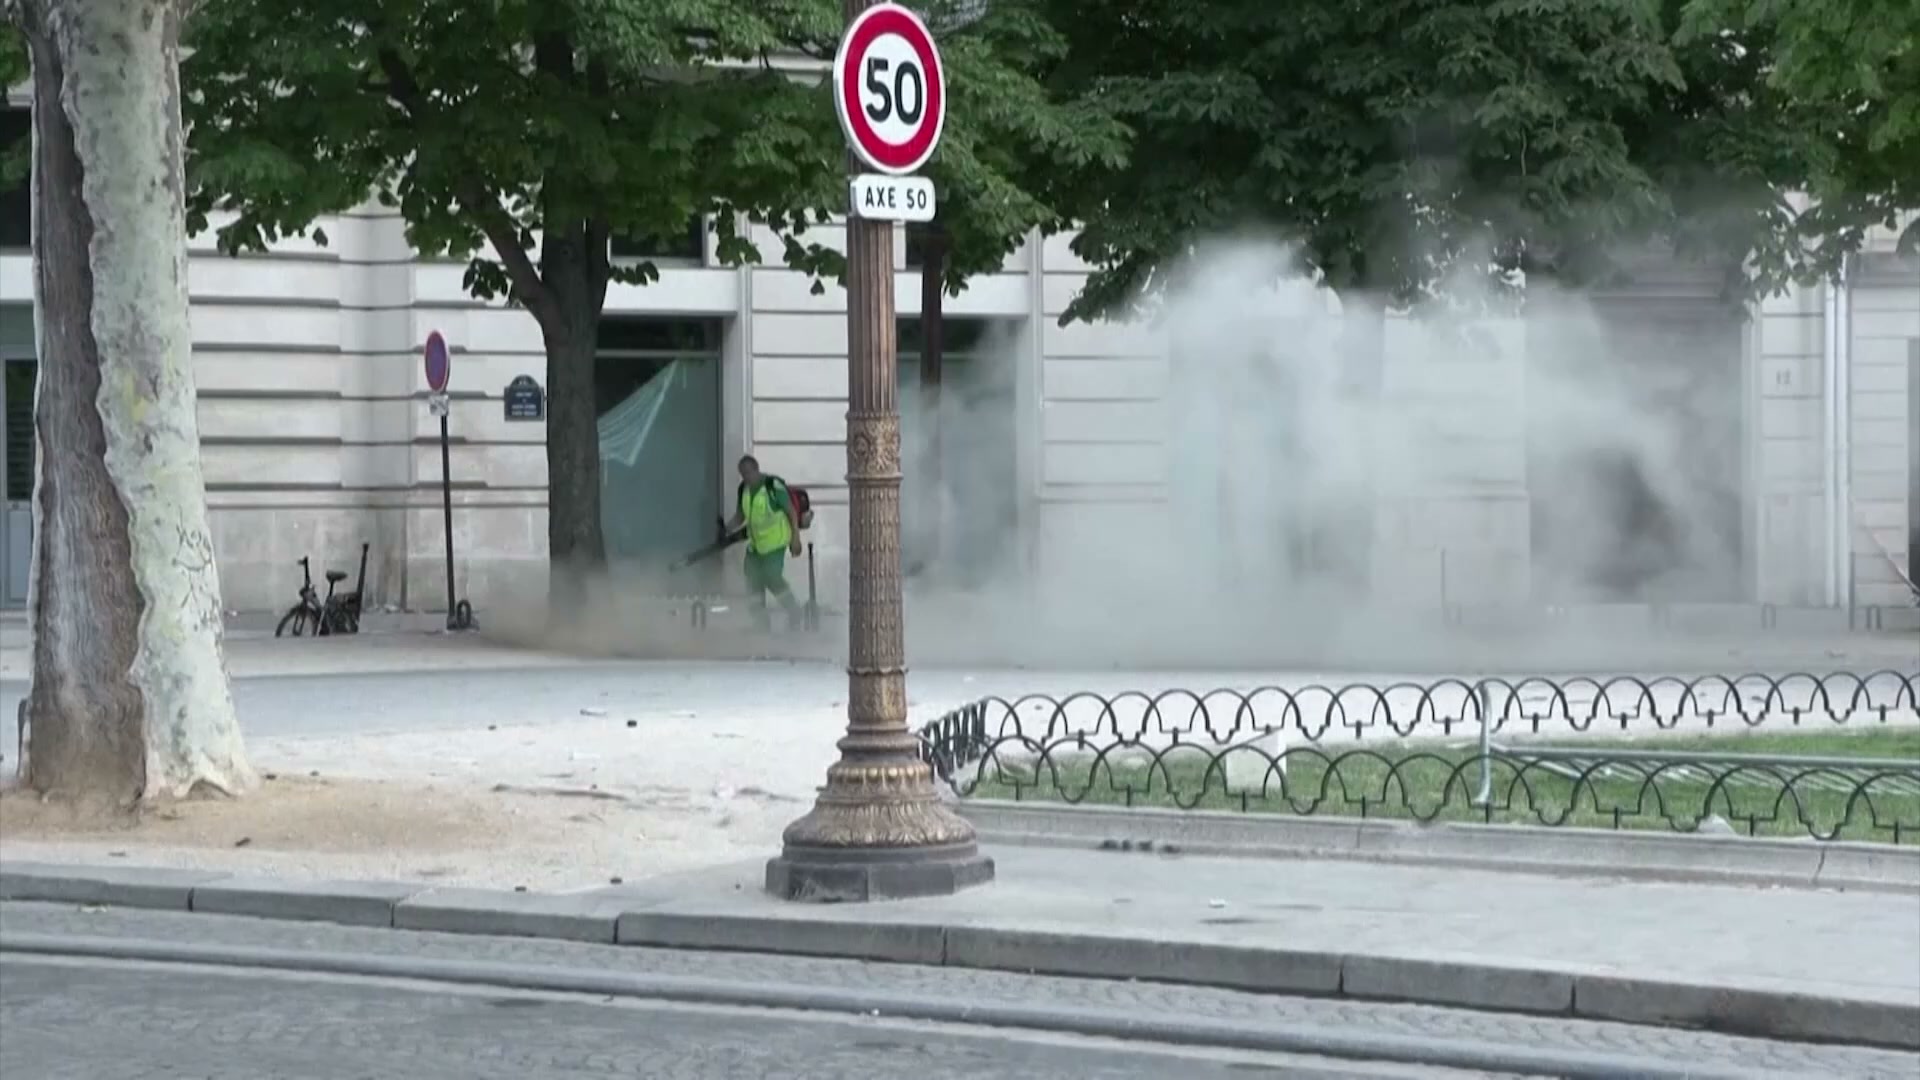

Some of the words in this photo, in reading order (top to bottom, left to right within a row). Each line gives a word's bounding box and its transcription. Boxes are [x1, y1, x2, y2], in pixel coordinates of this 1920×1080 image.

[866, 57, 922, 125] 50
[866, 186, 896, 208] AXE
[907, 188, 926, 209] 50
